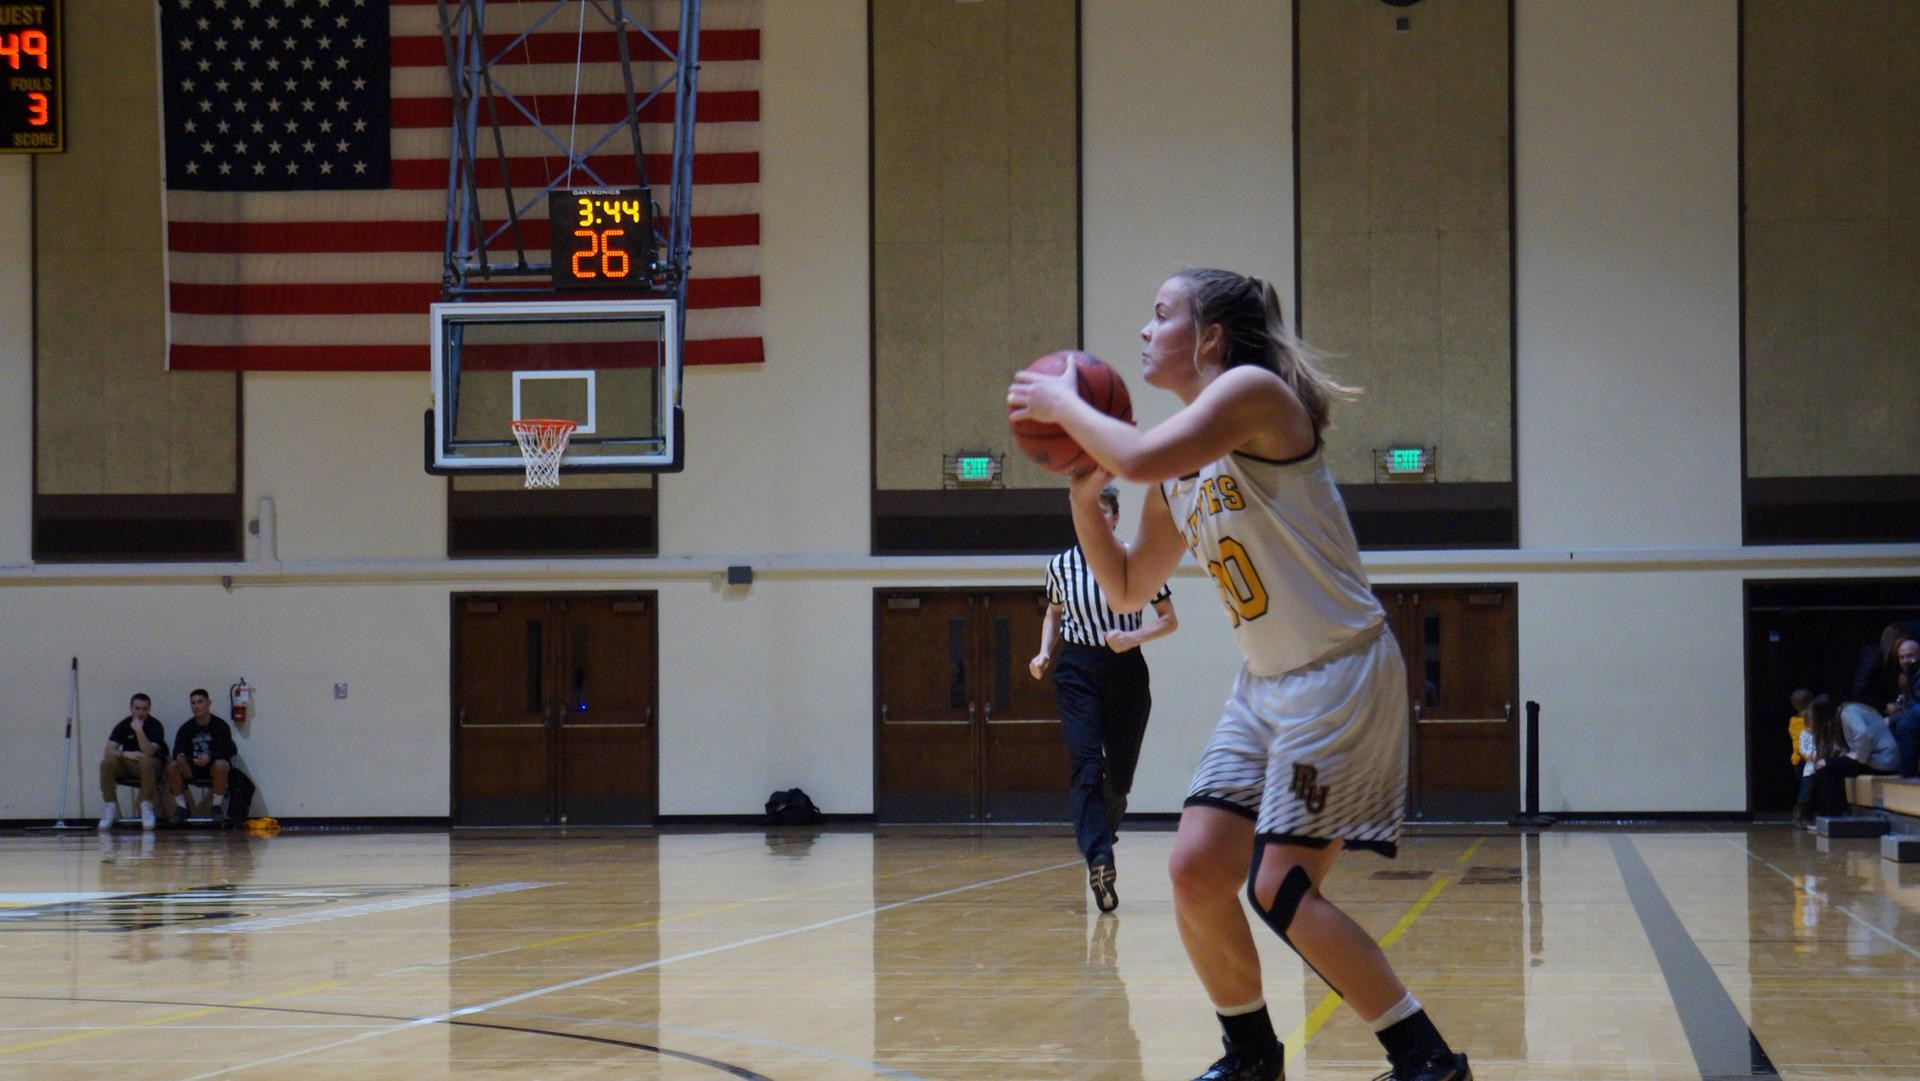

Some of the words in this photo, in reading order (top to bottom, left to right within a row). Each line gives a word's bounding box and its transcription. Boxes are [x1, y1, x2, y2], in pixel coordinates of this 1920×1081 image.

[0, 29, 48, 69] 49
[11, 78, 52, 91] FOULS
[28, 92, 48, 125] 3
[14, 133, 56, 146] SCORE
[579, 199, 639, 226] 3:44
[572, 229, 629, 278] 26
[963, 458, 988, 478] EXIT
[1394, 449, 1419, 471] EXIT
